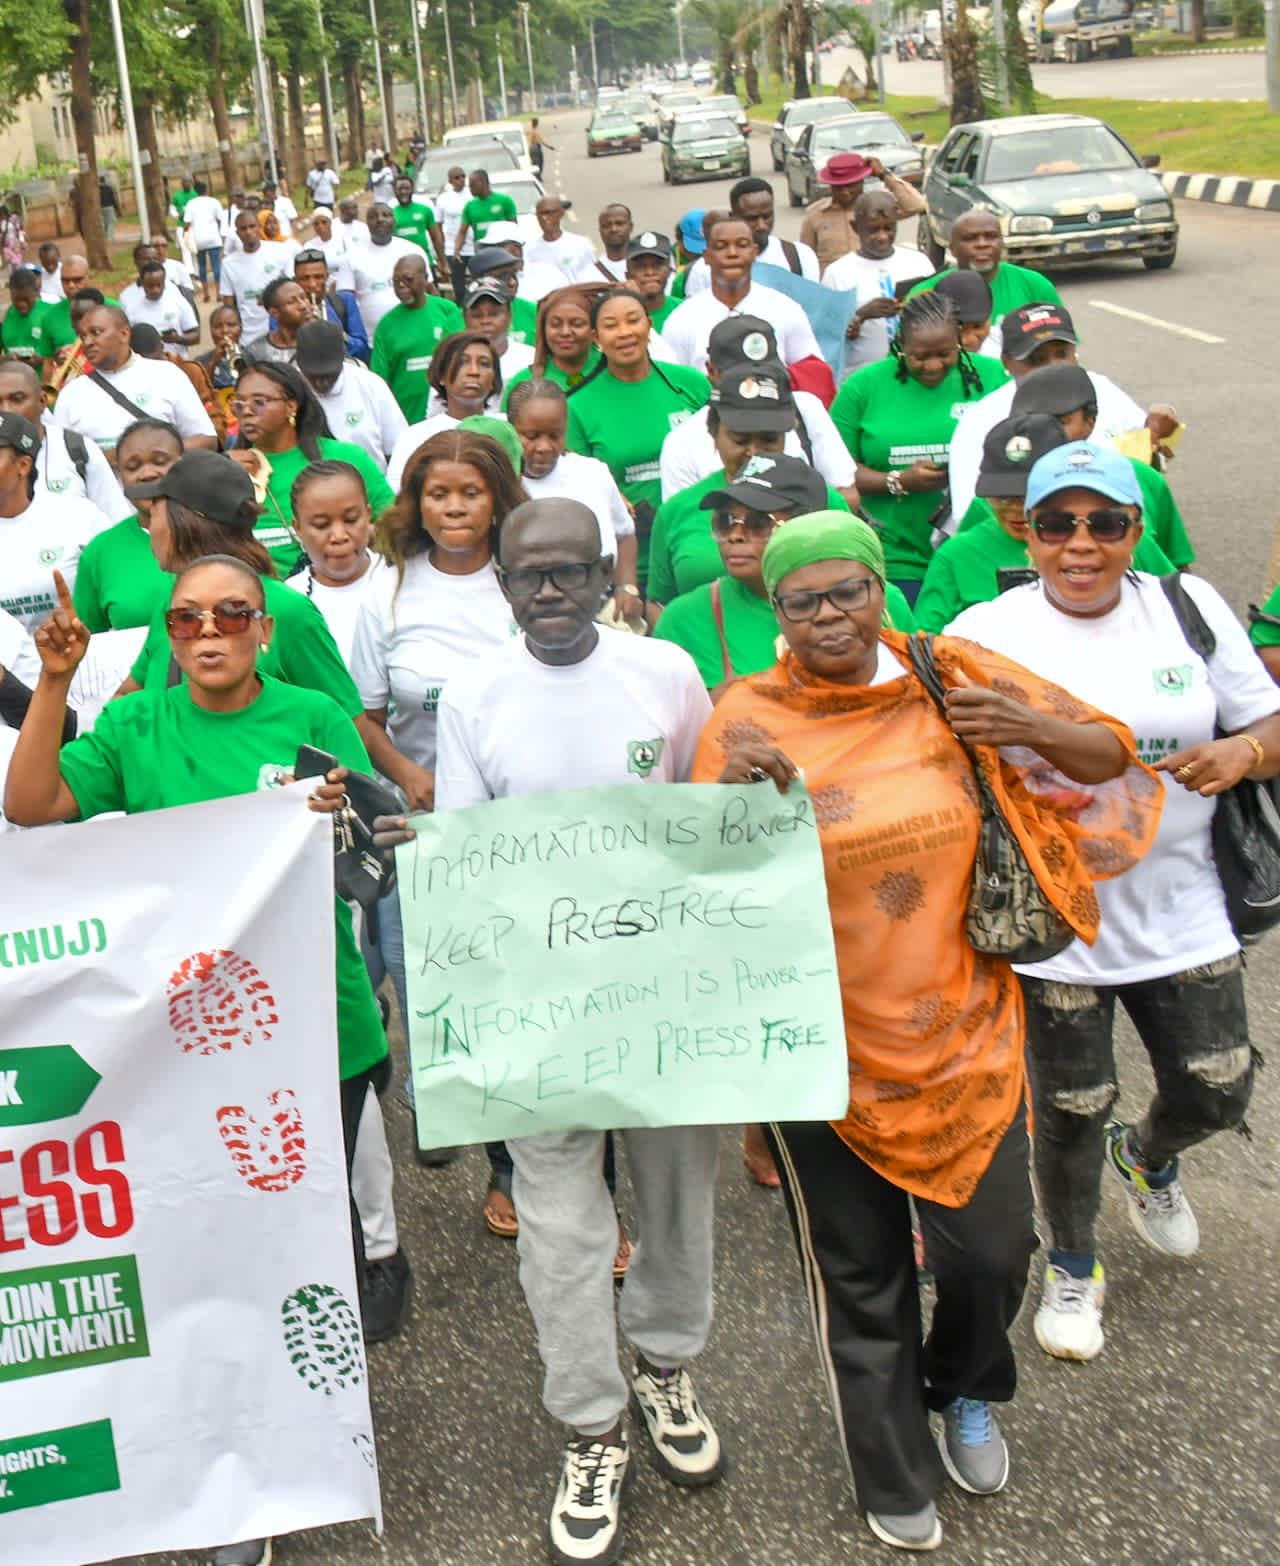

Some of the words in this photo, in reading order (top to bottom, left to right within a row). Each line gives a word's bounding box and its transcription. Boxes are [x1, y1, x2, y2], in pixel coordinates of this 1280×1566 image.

[1148, 738, 1164, 750] IN
[1167, 738, 1178, 750] A
[666, 815, 701, 845] IS
[420, 915, 515, 977] KEEP
[416, 975, 660, 1070] INFORMATION
[684, 970, 719, 1000] IS
[482, 1036, 630, 1116] KEEP
[656, 1021, 752, 1076] PRESS
[759, 1017, 828, 1063] FREE
[59, 1272, 125, 1315] THE
